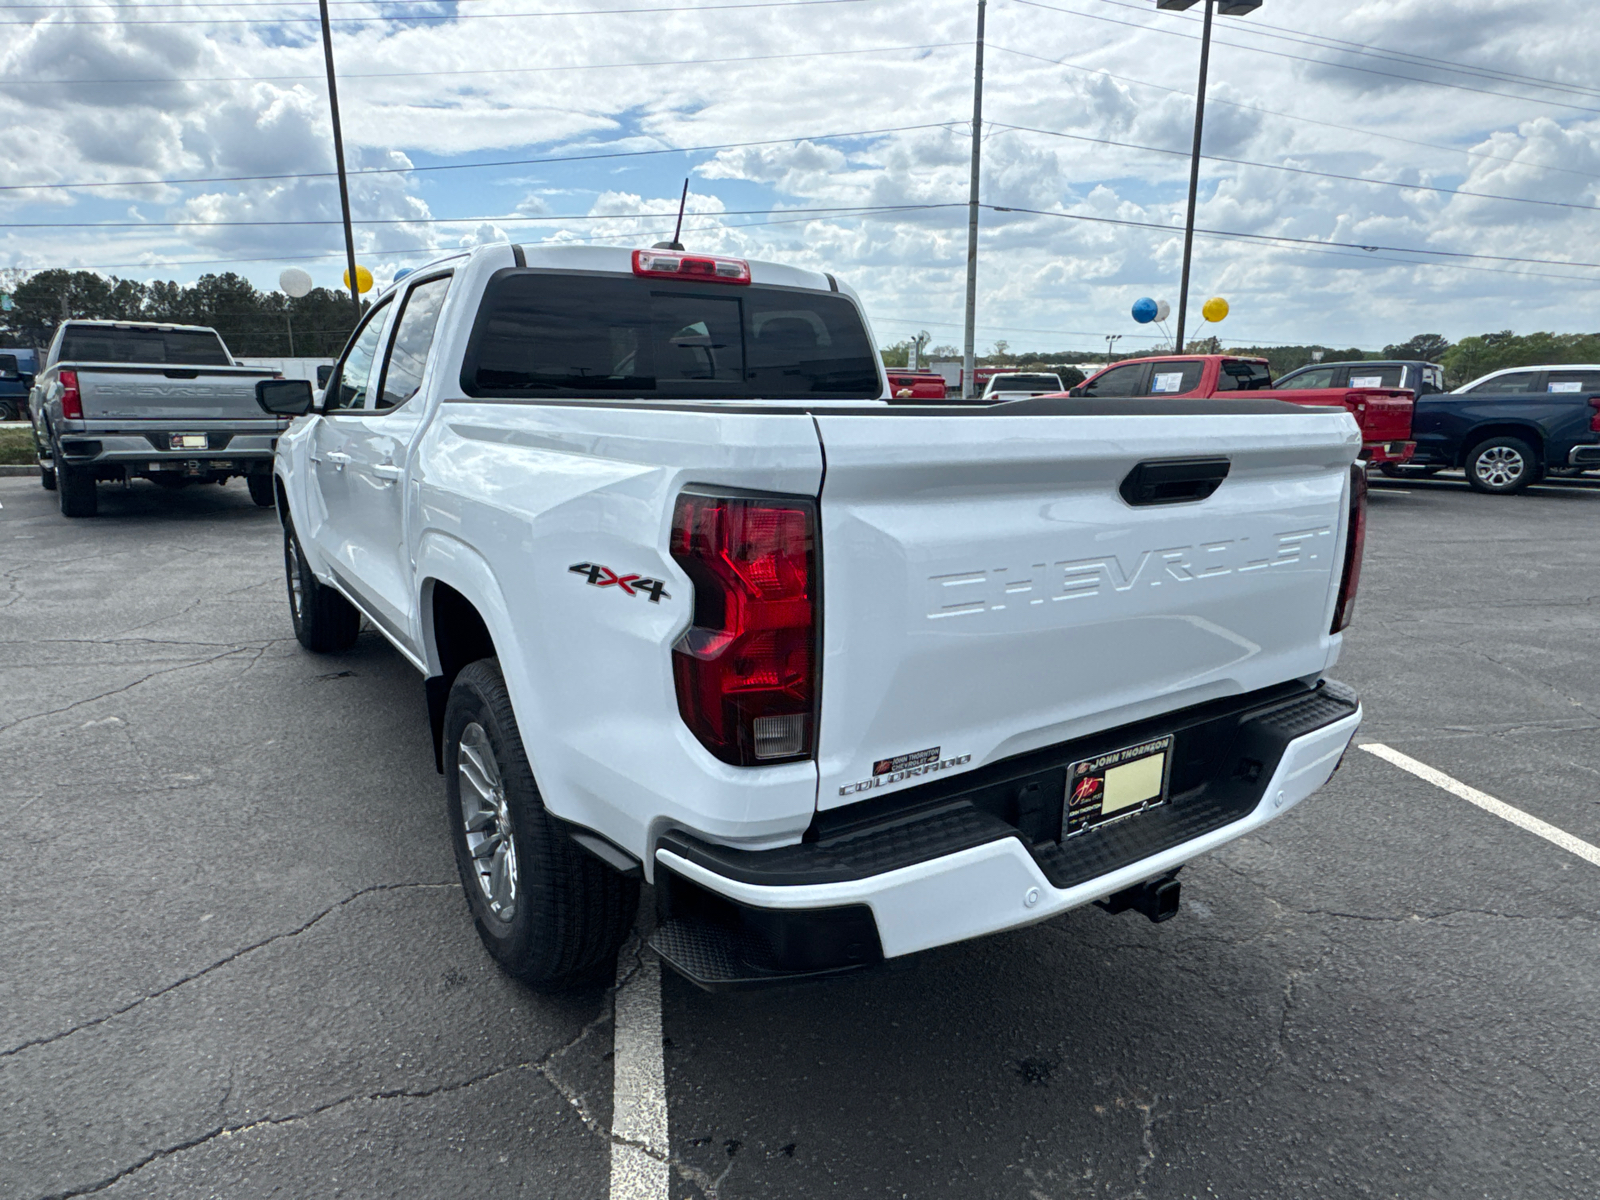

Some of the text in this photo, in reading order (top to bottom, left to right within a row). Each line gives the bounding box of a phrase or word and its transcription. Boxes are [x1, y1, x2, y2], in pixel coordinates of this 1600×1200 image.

[926, 524, 1331, 619] CHEVROLET
[892, 747, 939, 766] JOHN THORNTON
[1092, 738, 1170, 770] JOHN THORNTON
[838, 753, 972, 796] COLORADO
